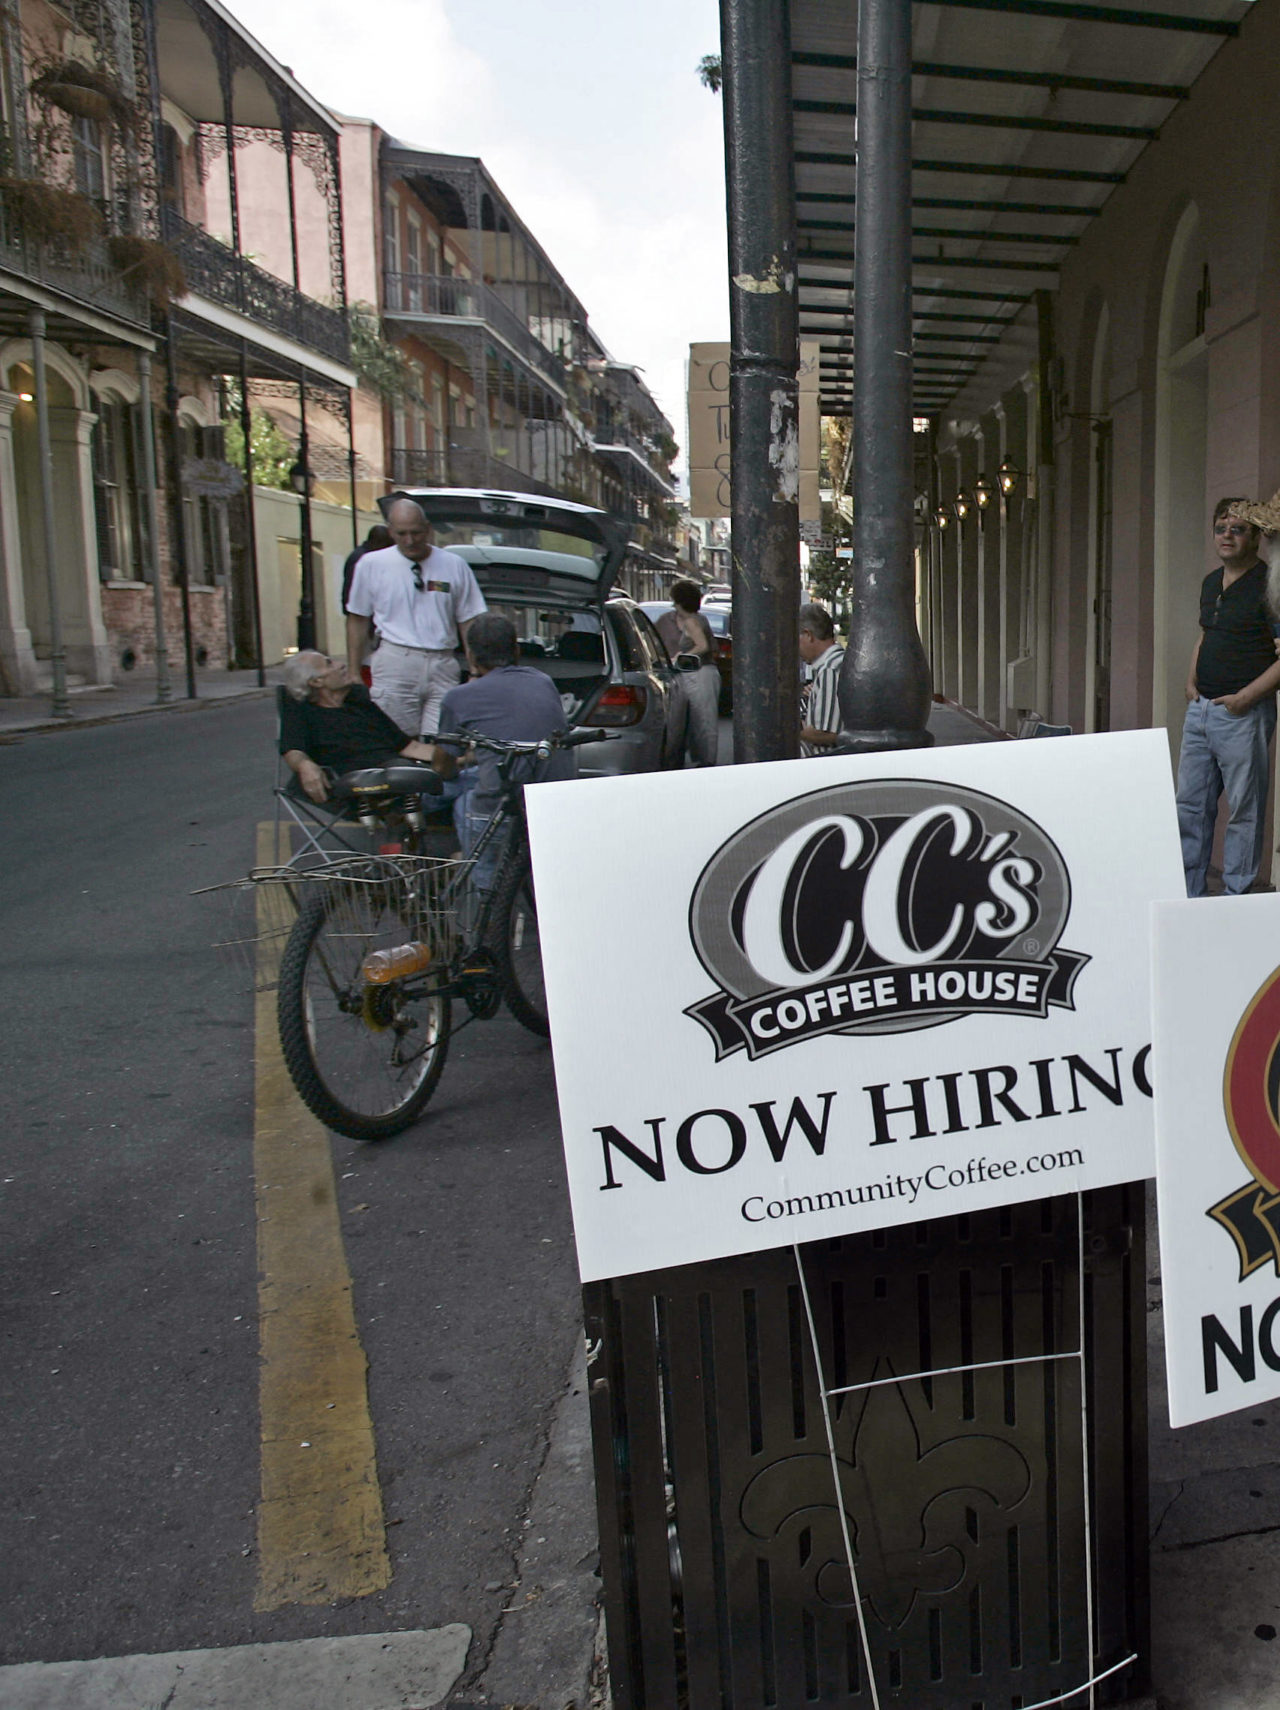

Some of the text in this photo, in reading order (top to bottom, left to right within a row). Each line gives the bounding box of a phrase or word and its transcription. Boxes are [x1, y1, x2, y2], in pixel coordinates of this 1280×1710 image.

[742, 804, 1035, 987] CC's
[750, 970, 1039, 1041] COFFEE HOUSE
[592, 1089, 838, 1192] NOW
[740, 1142, 1086, 1225] CommunityCoffee.com
